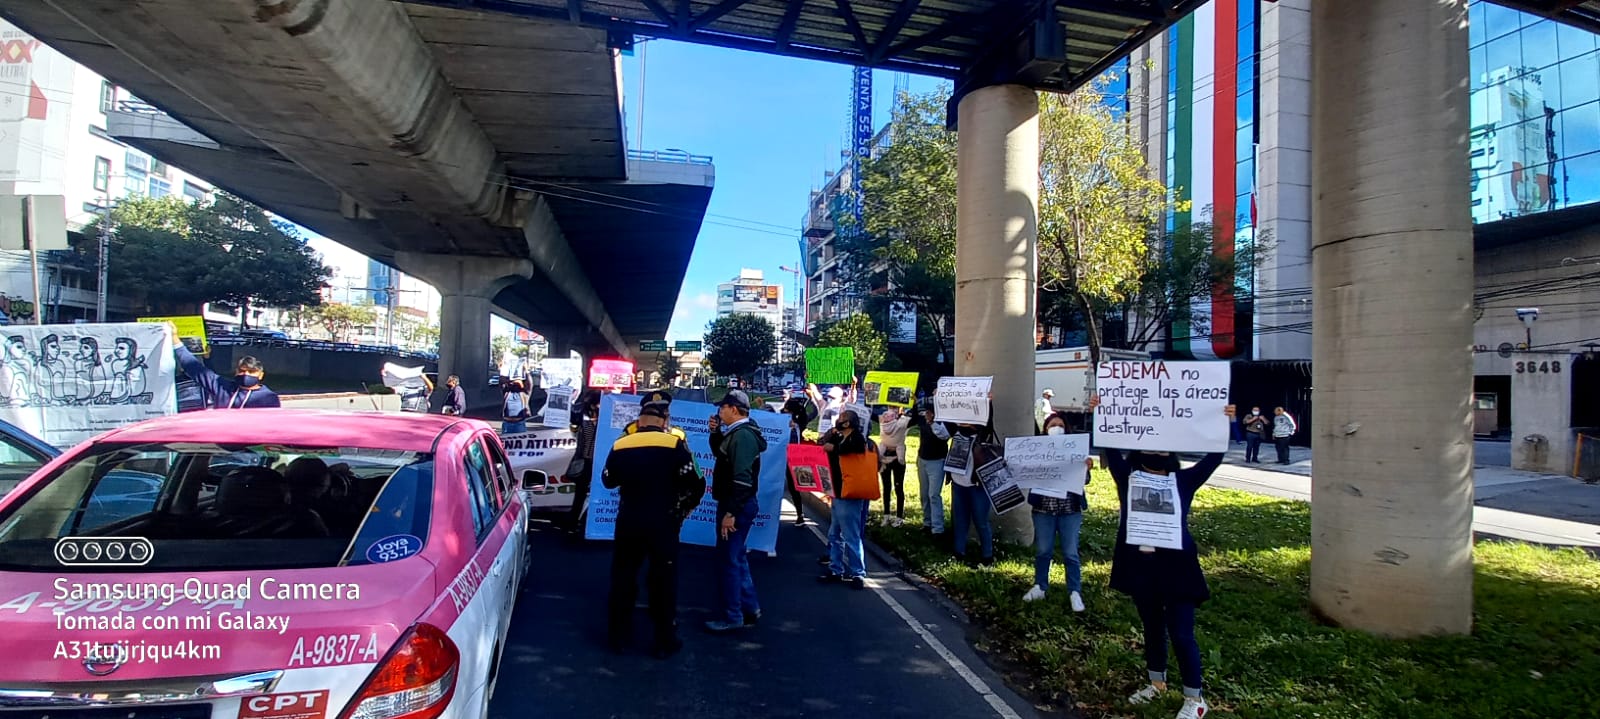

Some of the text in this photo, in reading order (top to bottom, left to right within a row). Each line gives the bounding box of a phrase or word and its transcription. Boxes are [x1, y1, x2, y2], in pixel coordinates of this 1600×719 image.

[1098, 361, 1200, 381] SEDEMA no
[1515, 361, 1561, 374] 3648
[1099, 380, 1228, 405] protege las áreas
[1171, 399, 1193, 418] las
[1099, 416, 1160, 440] destruye.
[376, 538, 409, 554] Joya
[379, 546, 409, 562] 93.7
[450, 559, 485, 615] A-9837-A
[288, 632, 378, 667] A-9837-A
[248, 692, 323, 712] CPT
